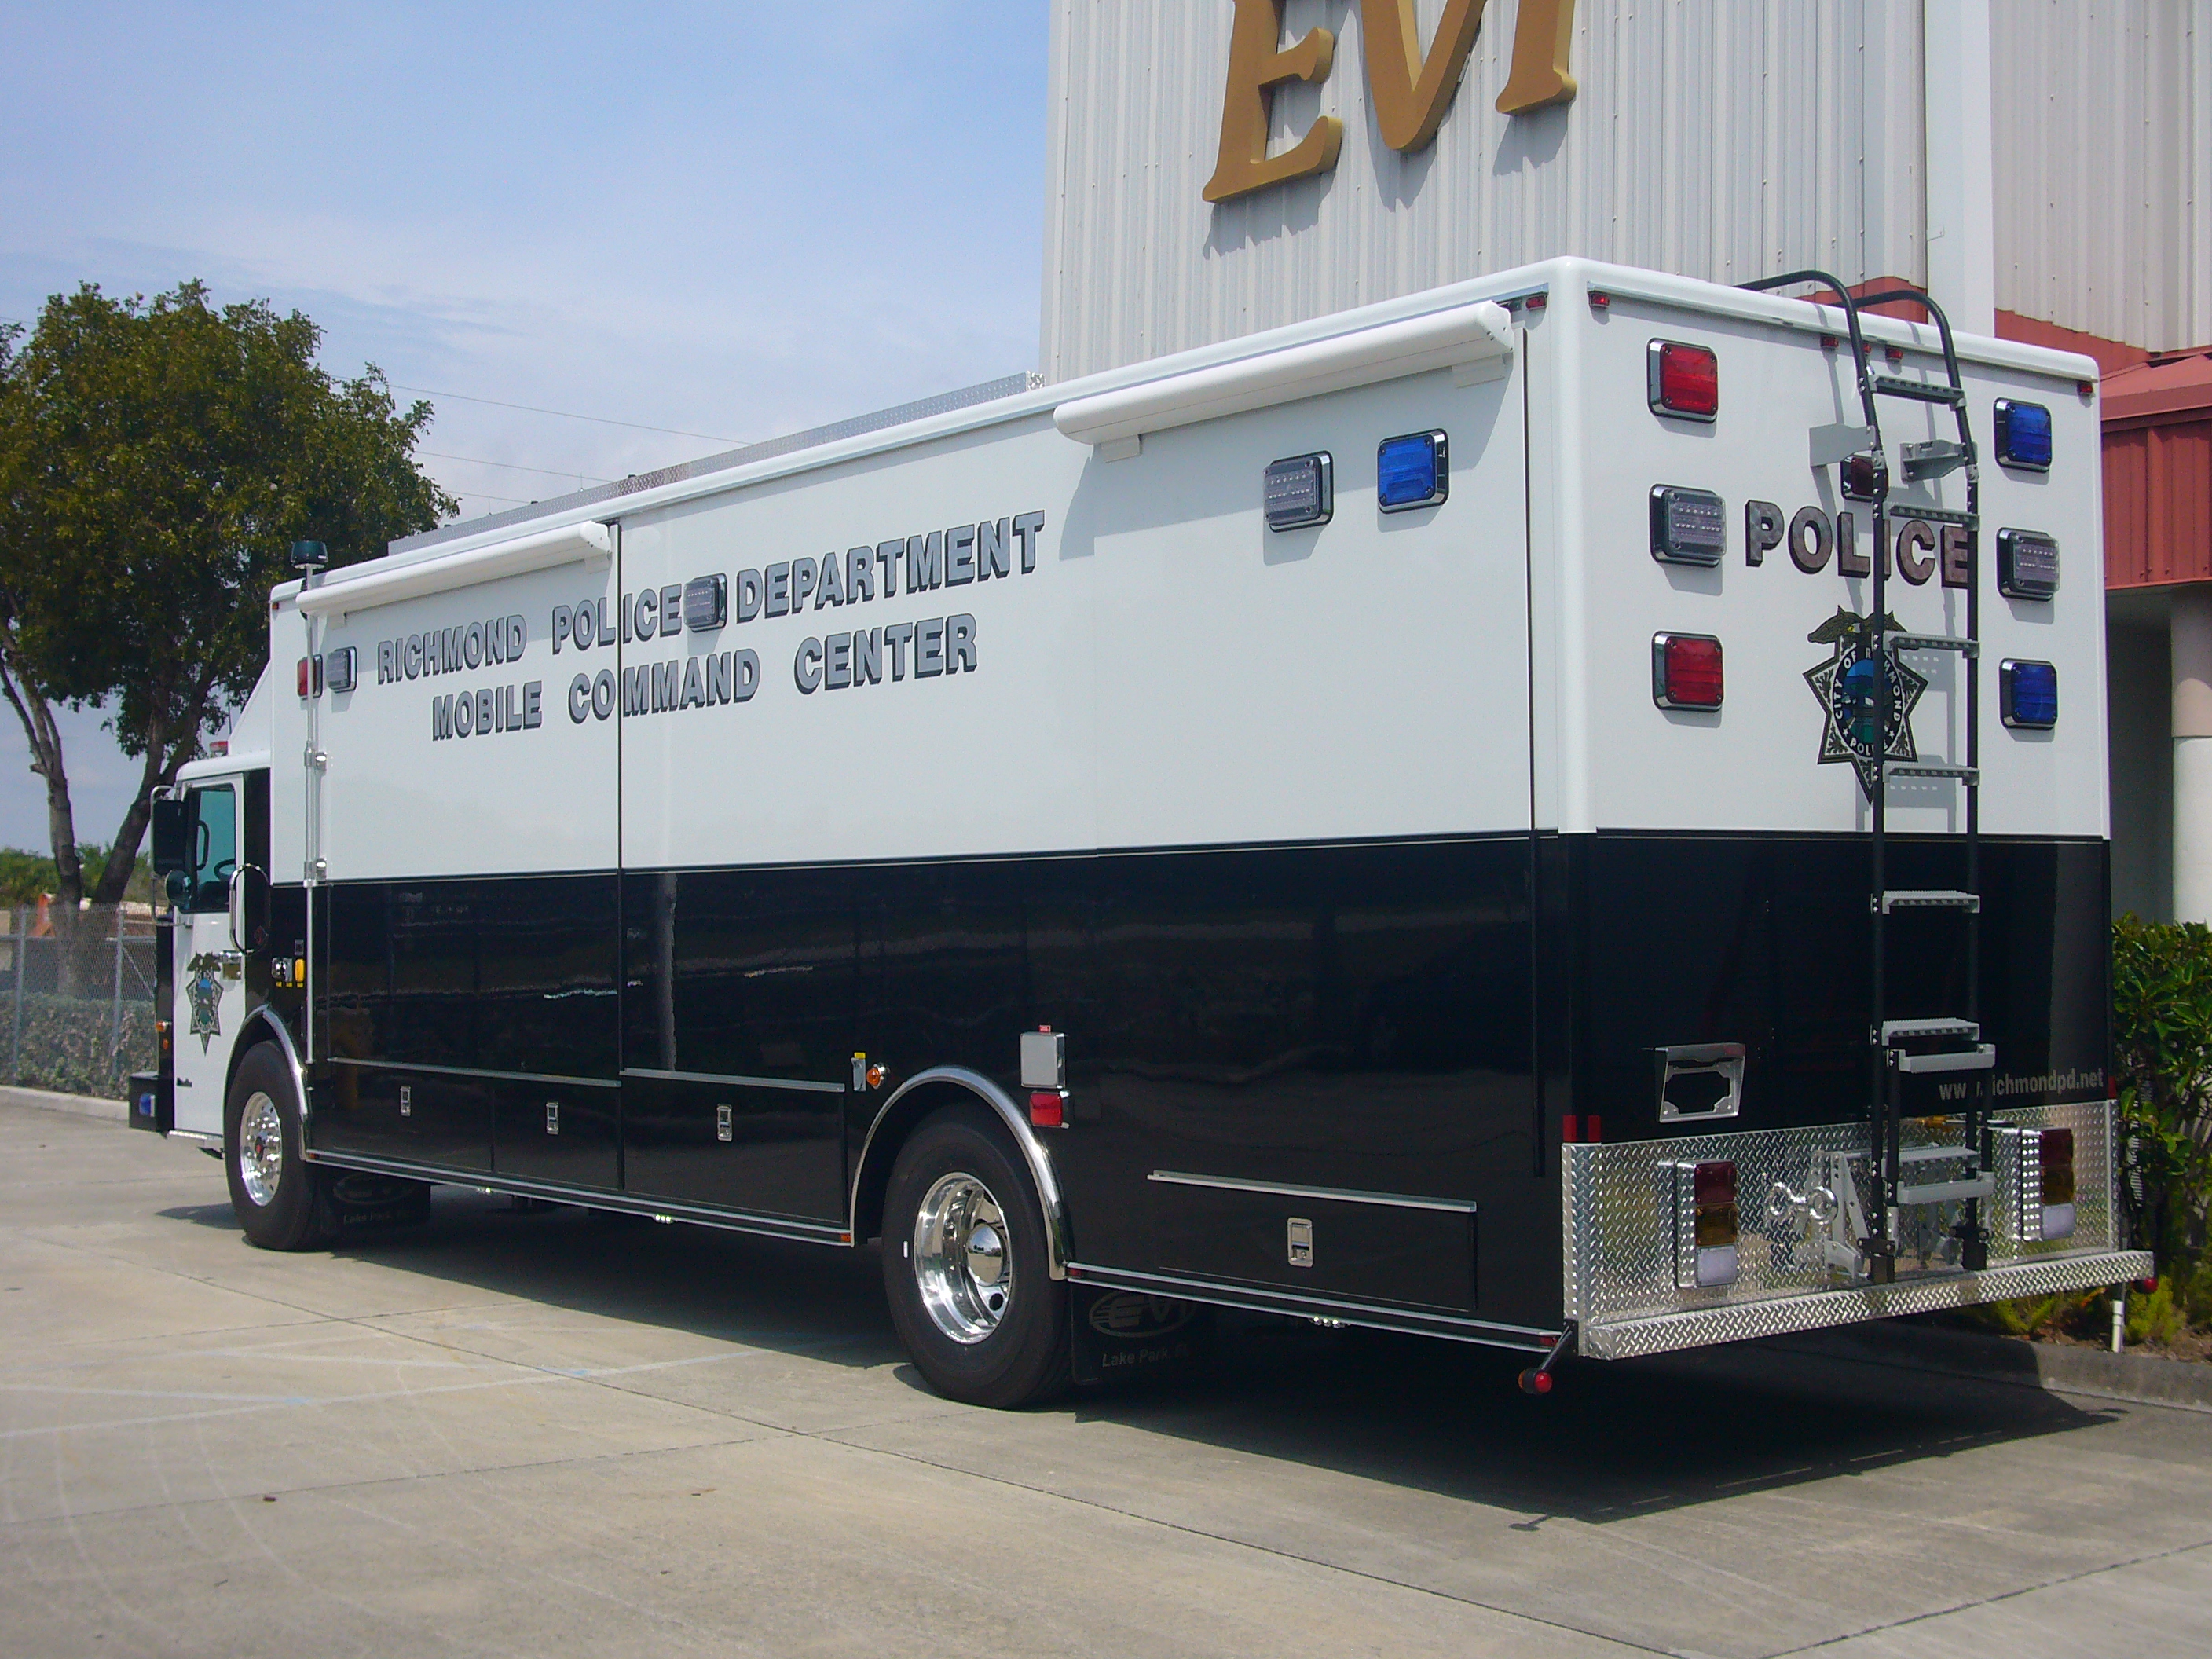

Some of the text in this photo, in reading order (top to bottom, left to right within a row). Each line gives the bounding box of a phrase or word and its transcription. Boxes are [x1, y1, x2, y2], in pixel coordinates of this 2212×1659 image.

[378, 510, 1046, 685] RICHMOND POLICE DEPARTMENT
[432, 613, 978, 742] MOBILE COMMAND CENTER
[1833, 647, 1902, 722] CITY OF RHMOND
[1939, 1067, 2104, 1101] ww.ichmondpd.net
[1101, 1351, 1135, 1368] Lake
